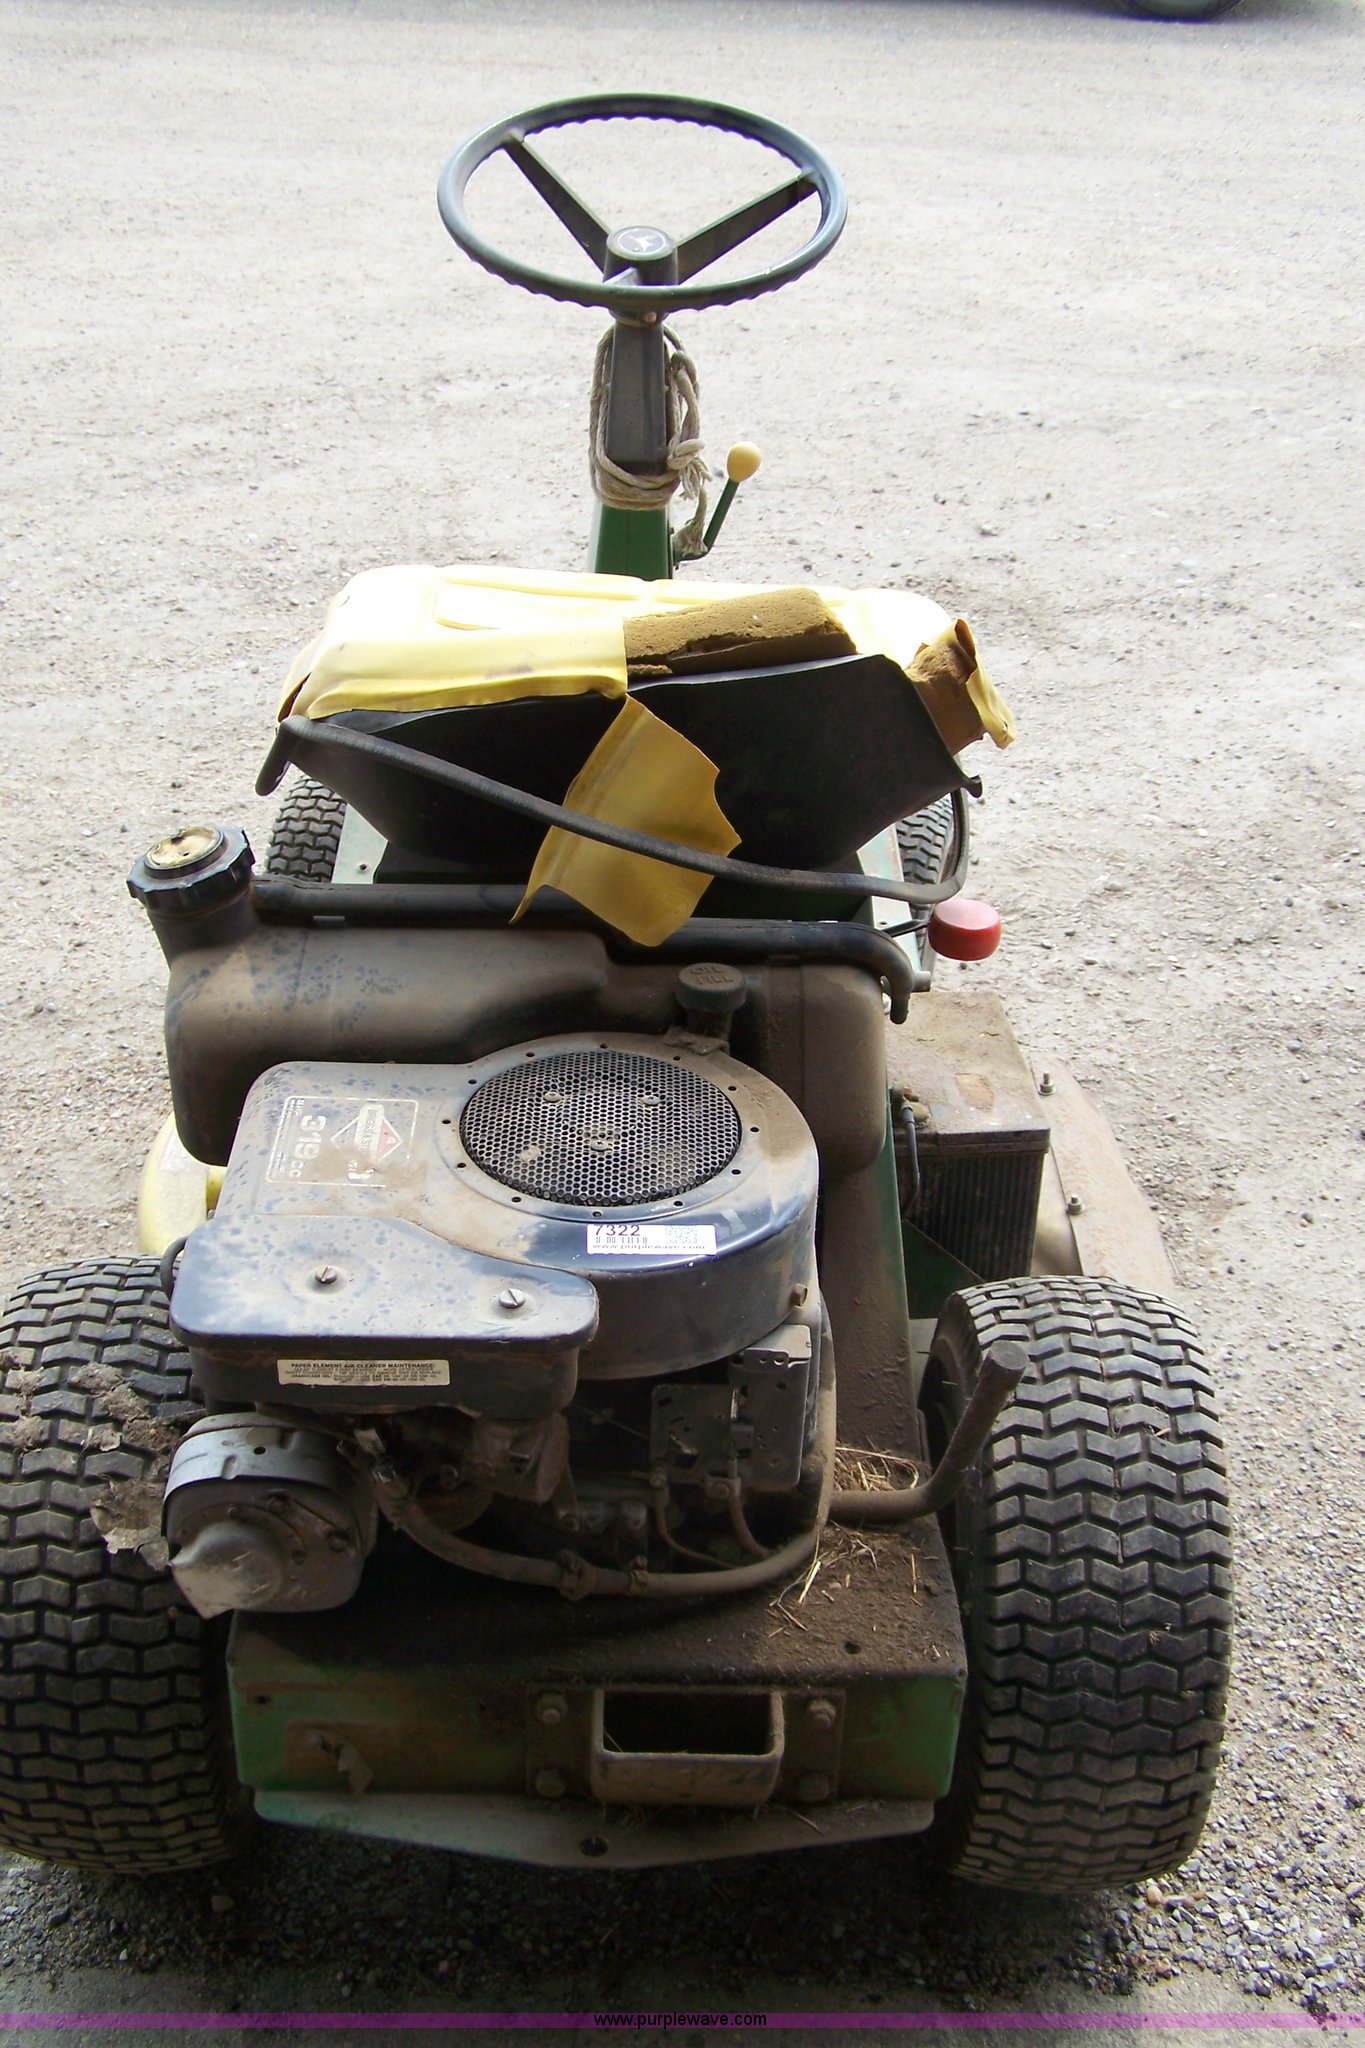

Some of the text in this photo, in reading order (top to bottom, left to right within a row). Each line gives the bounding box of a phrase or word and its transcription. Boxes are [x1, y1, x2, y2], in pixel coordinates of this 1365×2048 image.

[690, 966, 722, 975] OIL
[698, 975, 734, 985] FILL
[595, 1224, 641, 1237] 7322
